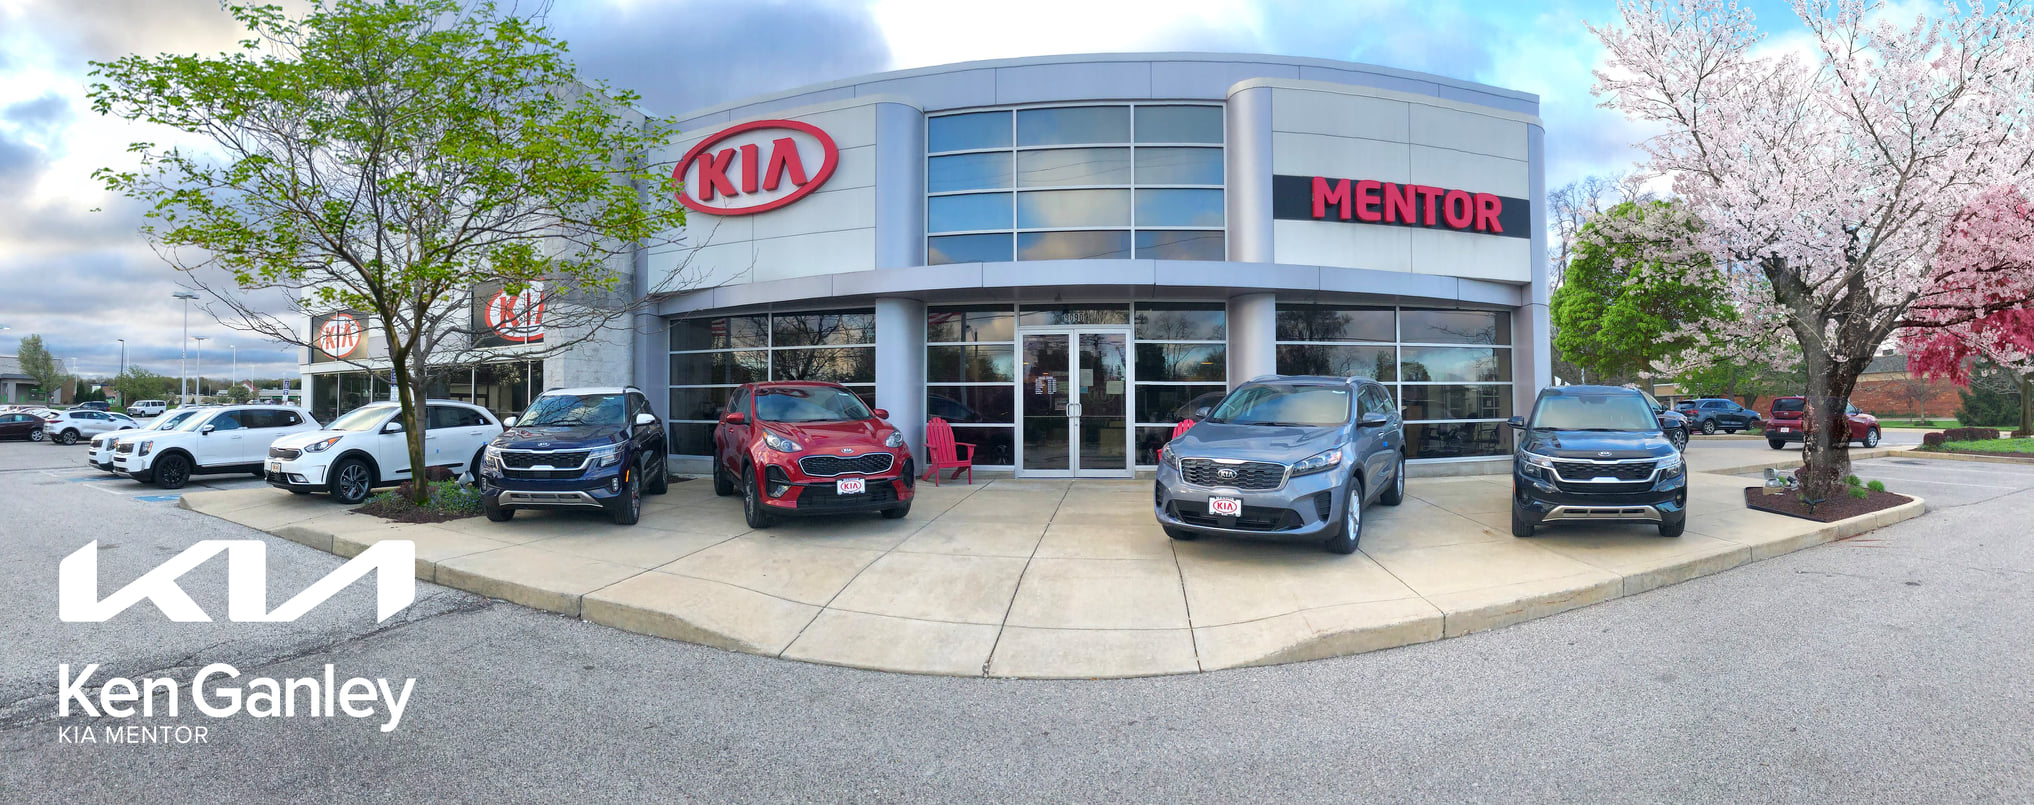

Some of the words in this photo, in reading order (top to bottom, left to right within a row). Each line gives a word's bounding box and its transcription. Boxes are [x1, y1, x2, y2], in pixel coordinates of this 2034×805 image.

[696, 137, 808, 201] KIA
[1312, 176, 1503, 233] MENTOR
[325, 323, 353, 350] KIA
[1220, 470, 1234, 478] KIA
[844, 482, 858, 490] KIA
[1217, 502, 1233, 511] KIA
